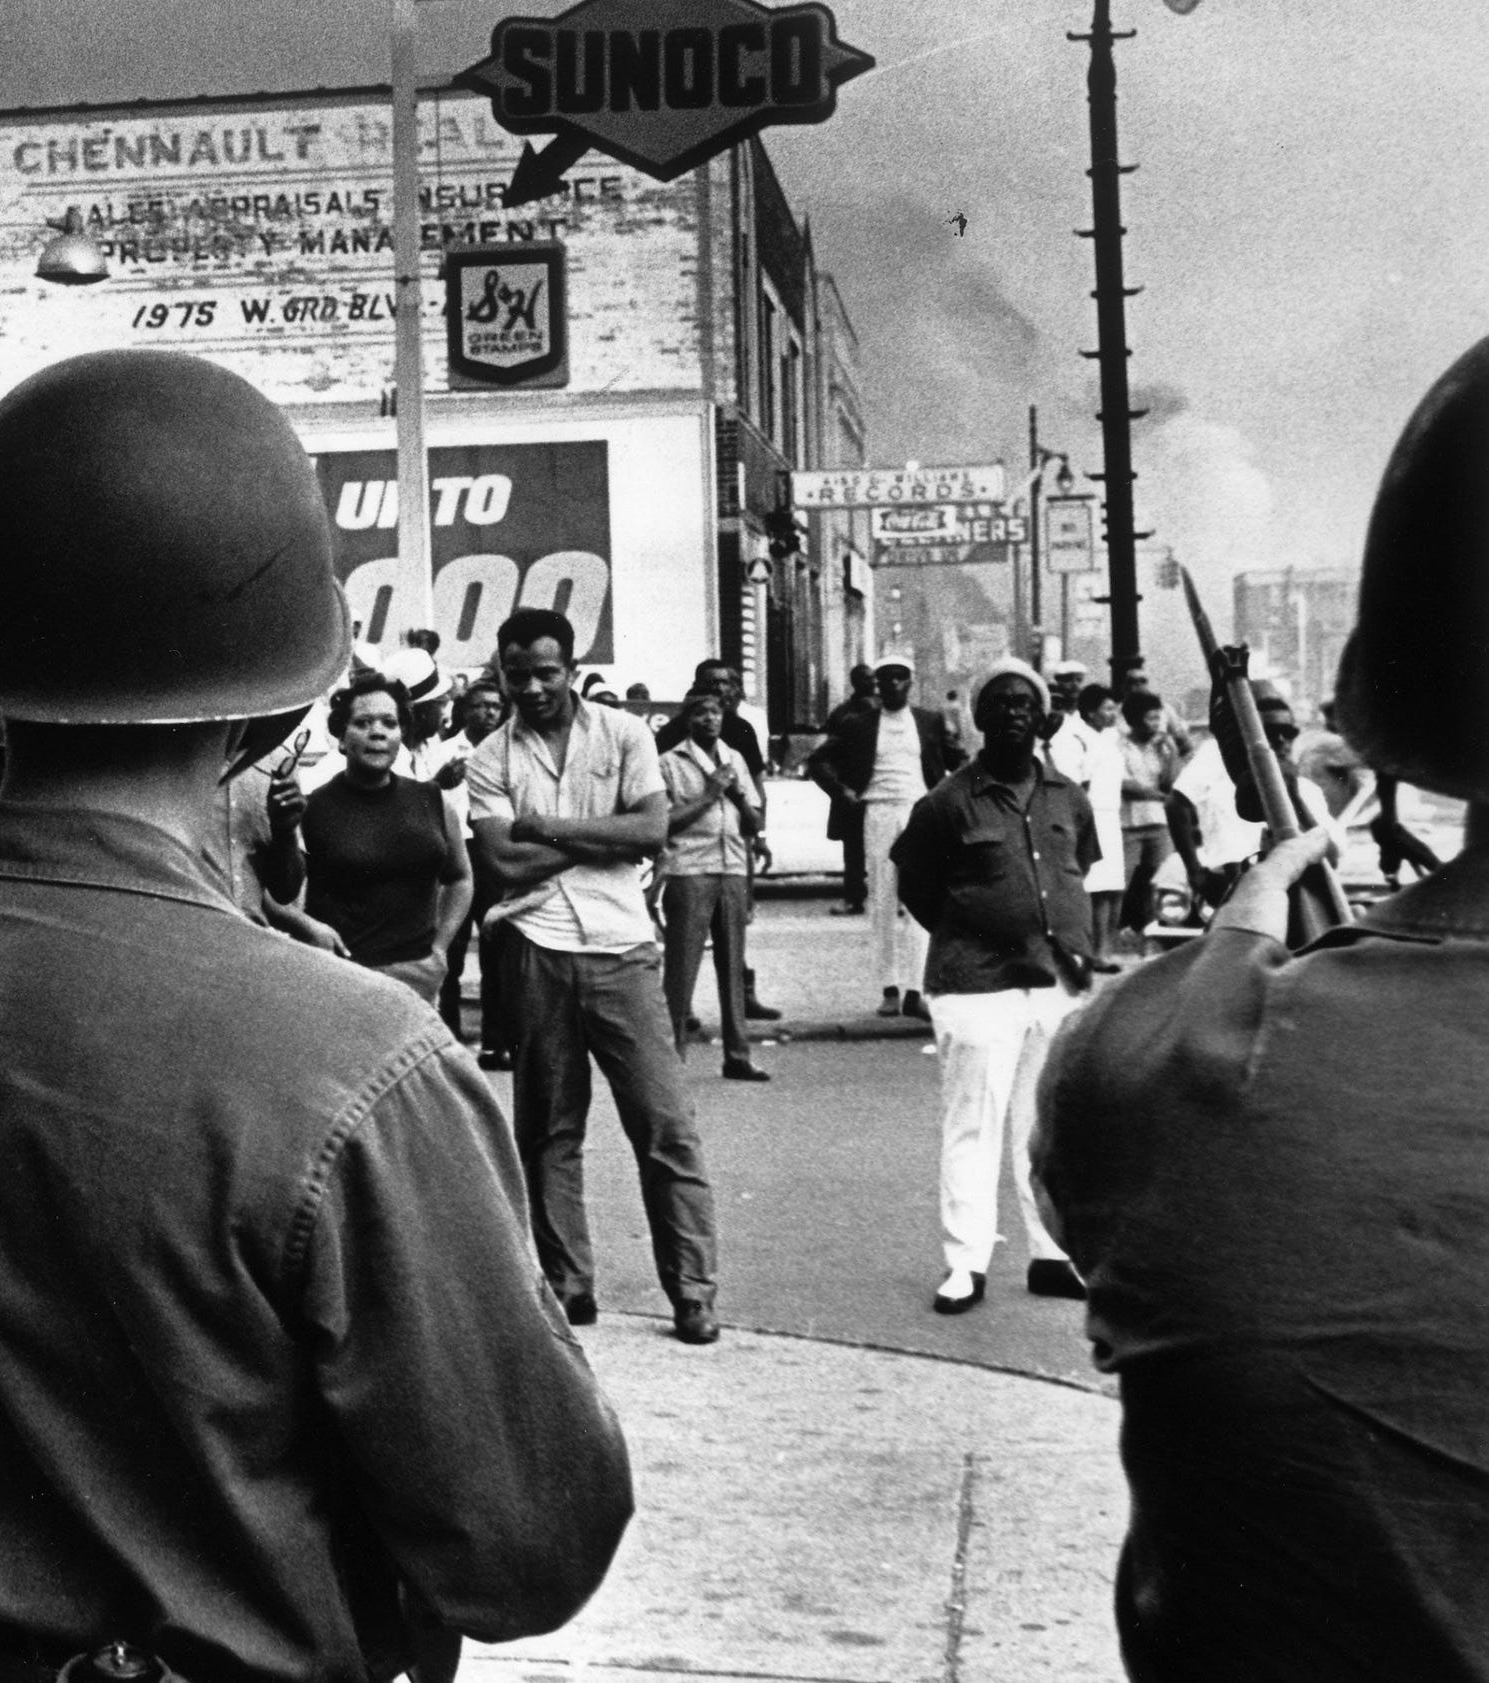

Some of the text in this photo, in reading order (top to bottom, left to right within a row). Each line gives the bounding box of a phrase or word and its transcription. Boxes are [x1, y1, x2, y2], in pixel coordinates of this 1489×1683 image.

[503, 14, 823, 116] SUNOCO
[12, 123, 321, 175] CHENNAULT
[182, 188, 382, 224] APPRAISALS
[297, 217, 568, 256] MANAEMENT
[132, 301, 218, 329] 1975
[432, 473, 513, 527] TO
[818, 481, 975, 502] RECORDS
